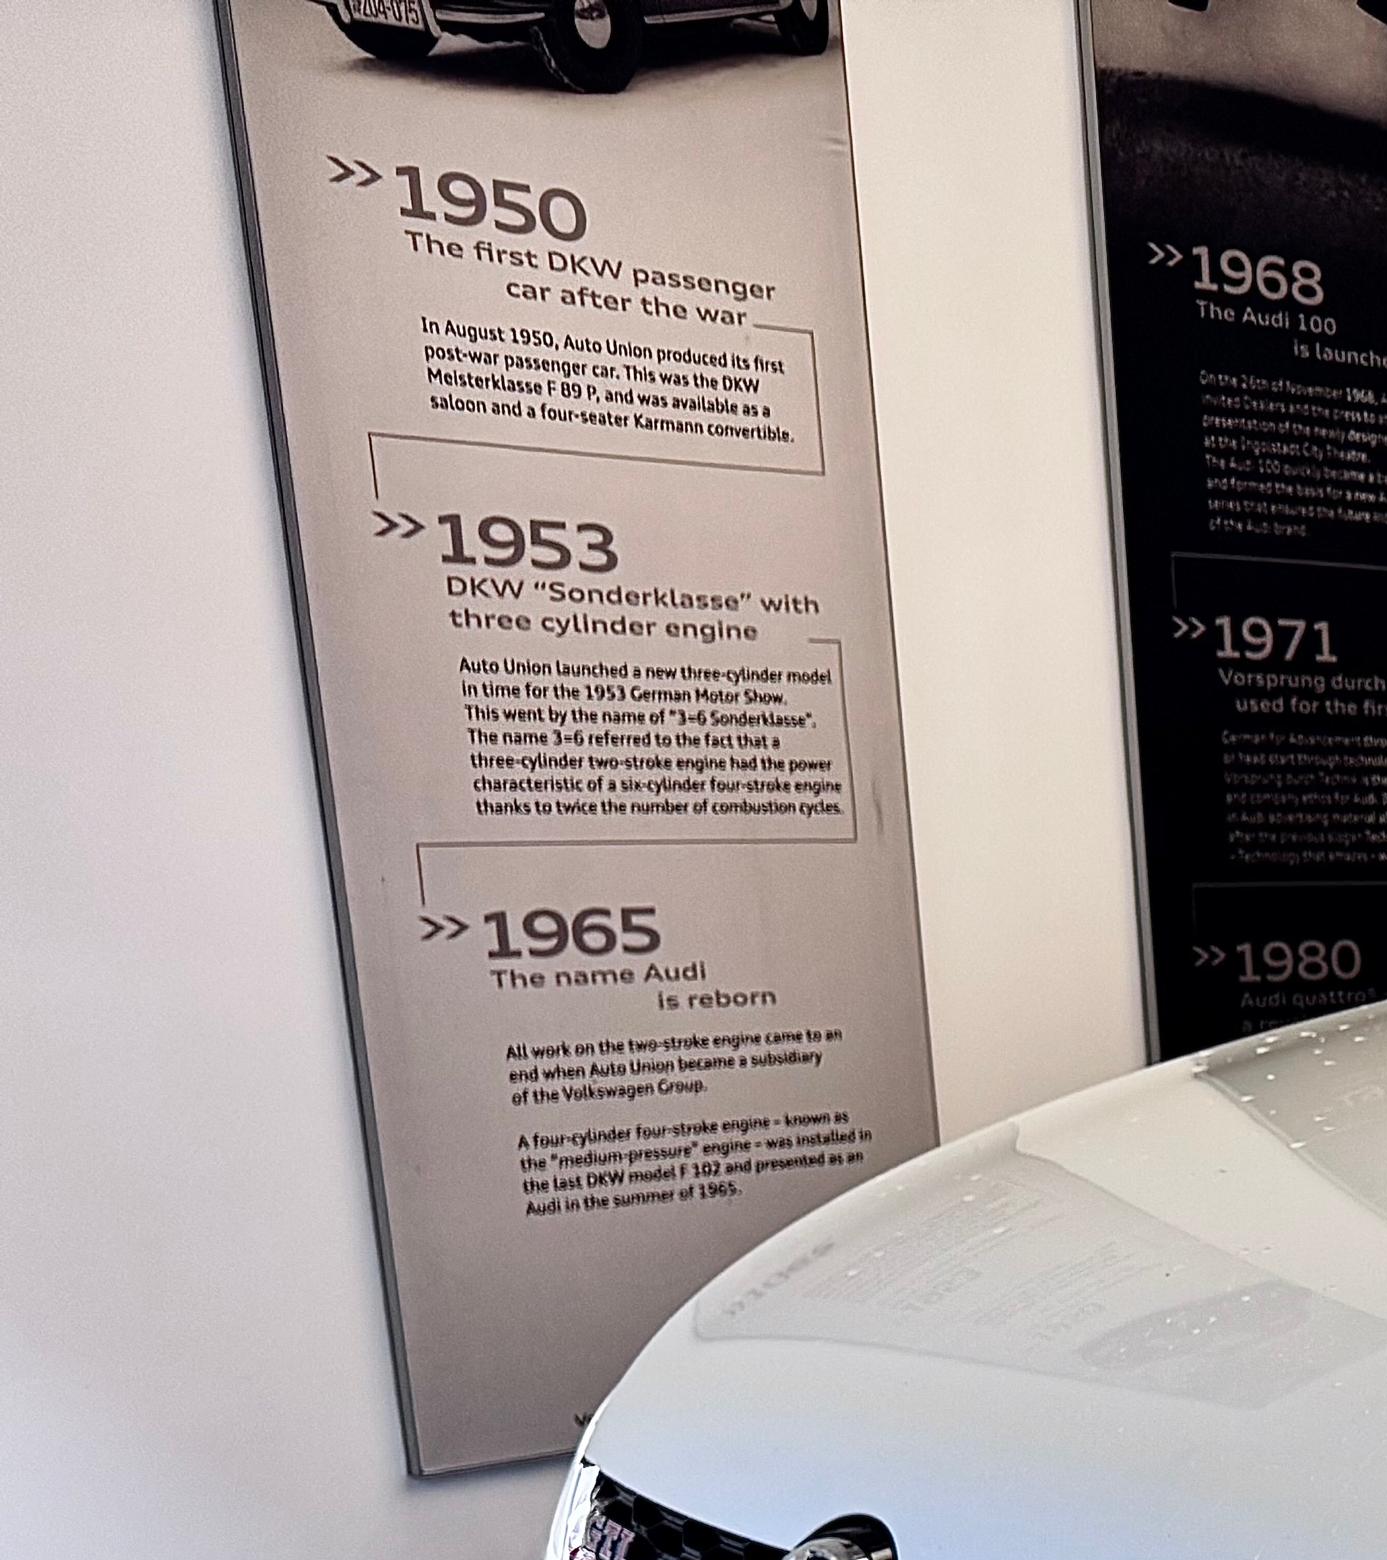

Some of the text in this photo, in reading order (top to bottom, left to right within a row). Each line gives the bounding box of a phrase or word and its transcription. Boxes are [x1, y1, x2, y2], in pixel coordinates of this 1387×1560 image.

[396, 165, 586, 241] 1950
[403, 229, 775, 301] The first DKW passenger
[1191, 245, 1324, 306] 1968
[505, 281, 747, 326] car after the war
[1197, 300, 1337, 335] The Audi 100
[420, 315, 785, 375] In August 1950, Auto Union produced its first
[1293, 338, 1310, 358] is
[423, 344, 759, 394] post-war passenger car. This was the DKW
[426, 367, 771, 418] Meisterklasse F 89 P, and was available as a
[429, 392, 794, 443] saloon and a four-seater Karmann convertible.
[438, 513, 617, 573] 1953
[446, 575, 524, 599] DKW
[759, 593, 819, 614] with
[448, 607, 757, 644] three cylinder engine
[1214, 615, 1338, 663] 1971
[458, 656, 832, 685] Auto Union launched a new three-cylinder model
[1218, 668, 1326, 693] Vorsprung
[1331, 672, 1386, 692] durch
[481, 680, 520, 699] time
[524, 681, 549, 699] for
[552, 682, 580, 701] the
[584, 683, 626, 701] 1953
[629, 684, 691, 703] German
[694, 687, 740, 704] Motor
[1235, 696, 1285, 715] used
[1290, 698, 1319, 715] for
[1325, 698, 1358, 717] the
[463, 703, 499, 722] This
[502, 707, 545, 722] went
[547, 704, 567, 725] by
[570, 706, 598, 724] the
[601, 710, 645, 725] name
[648, 707, 665, 725] of
[466, 726, 780, 750] The name 3=6 referred to the fact that a
[484, 906, 660, 959] 1965
[489, 960, 706, 989] The name Audi
[1235, 938, 1362, 983] 1980
[657, 989, 776, 1011] is reborn
[1240, 991, 1287, 1008] Audi
[505, 1028, 842, 1061] All work on the two-stroke engine came to an
[511, 1087, 529, 1106] of
[531, 1086, 559, 1104] the
[561, 1082, 654, 1101] Volkswagen
